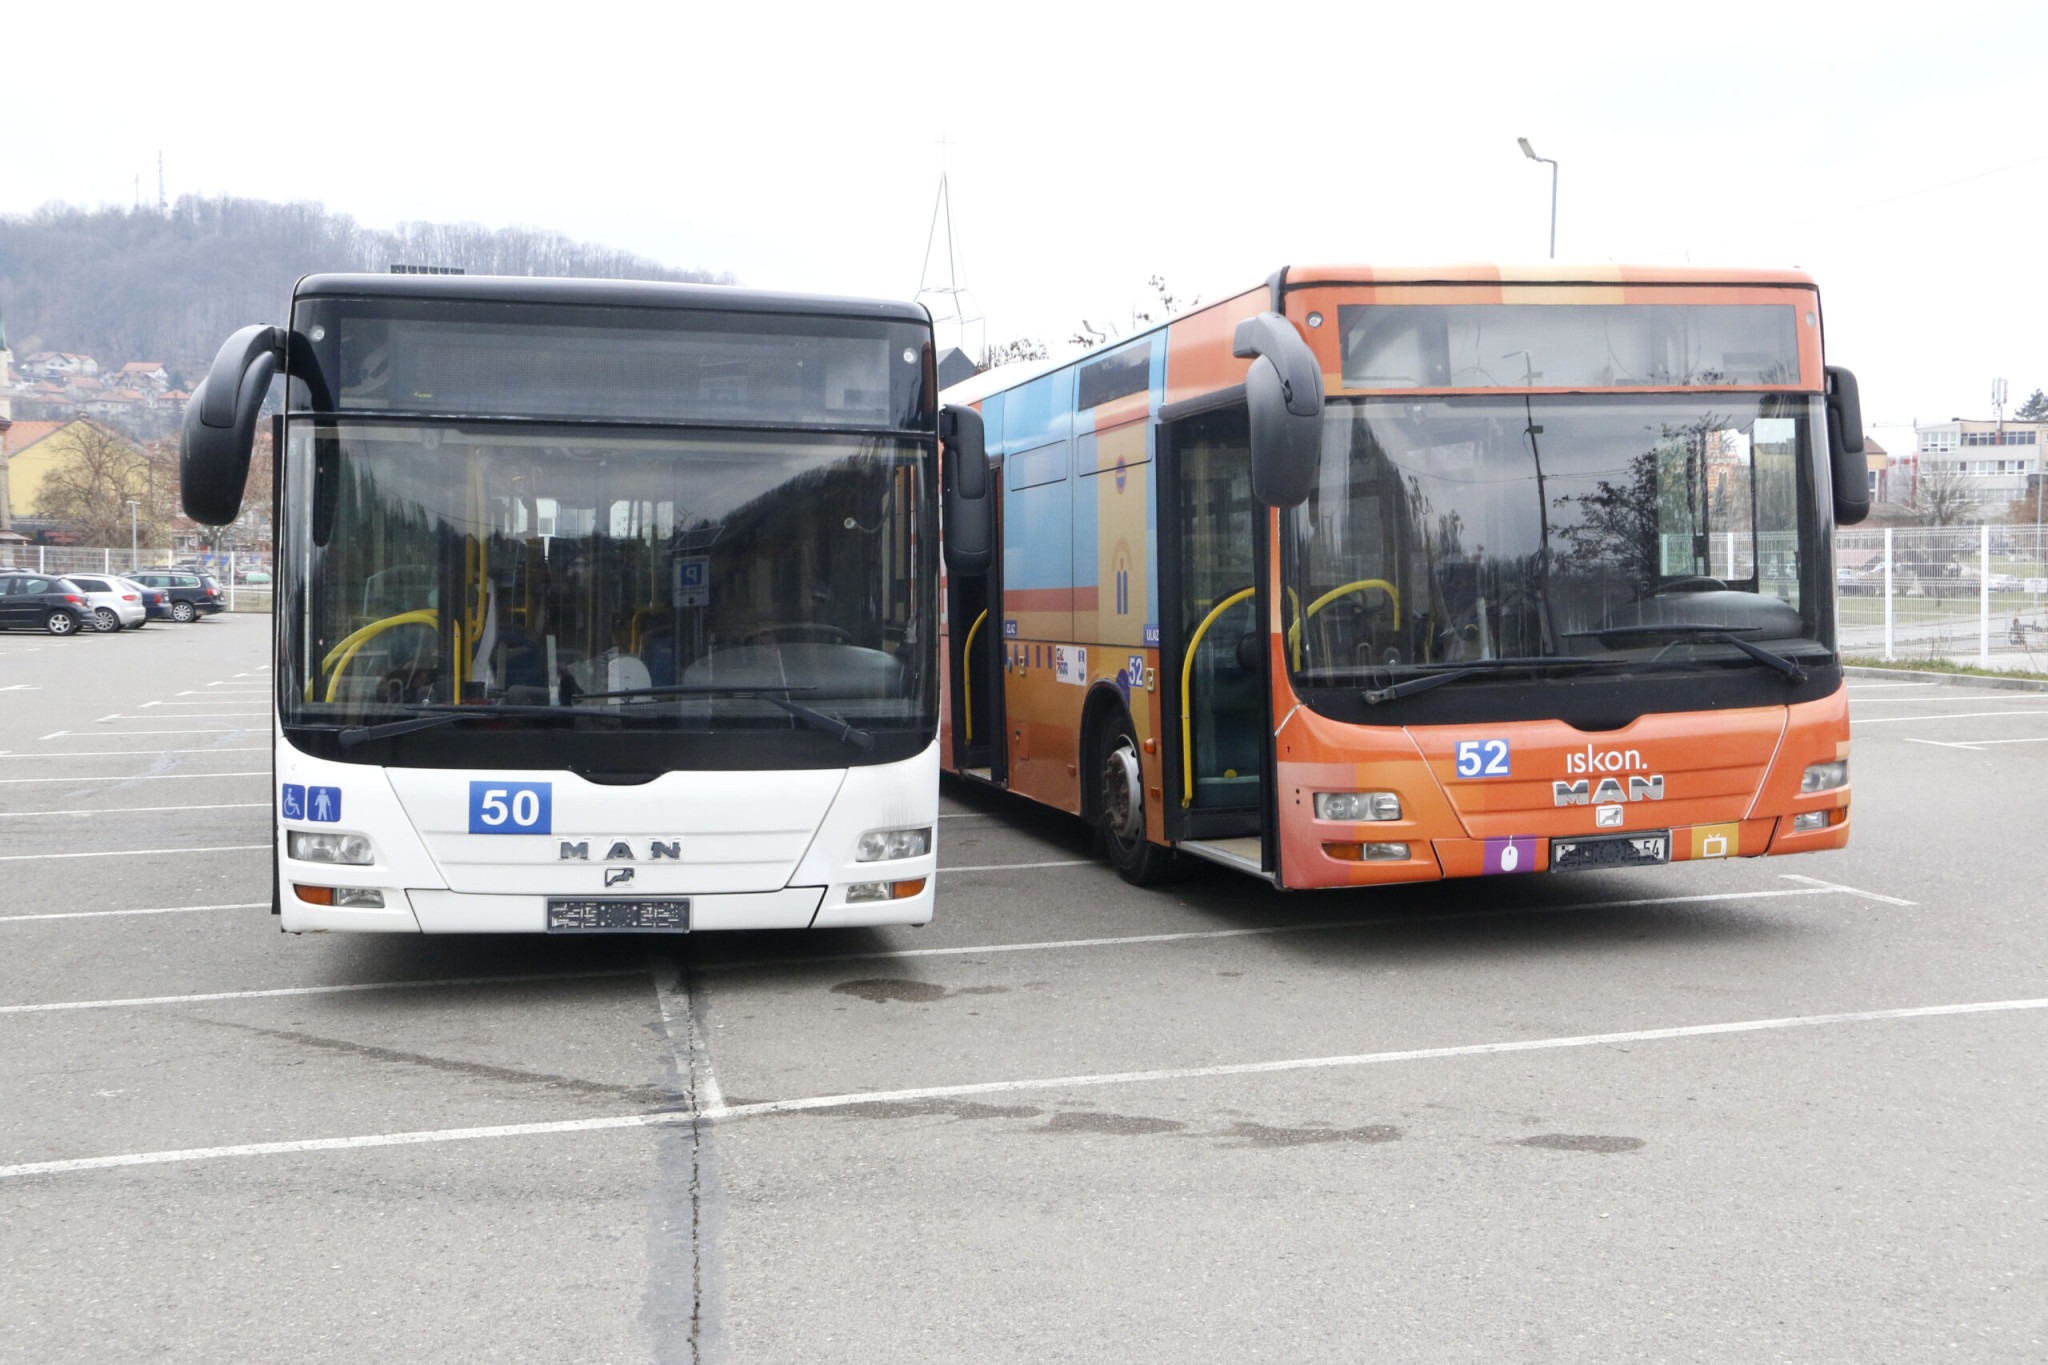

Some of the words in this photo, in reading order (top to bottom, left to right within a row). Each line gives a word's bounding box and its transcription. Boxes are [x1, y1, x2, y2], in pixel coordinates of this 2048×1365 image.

[1129, 657, 1143, 685] 52
[1458, 740, 1508, 776] 52
[1552, 775, 1664, 807] MAN
[481, 789, 540, 826] 50
[558, 838, 683, 861] MAN
